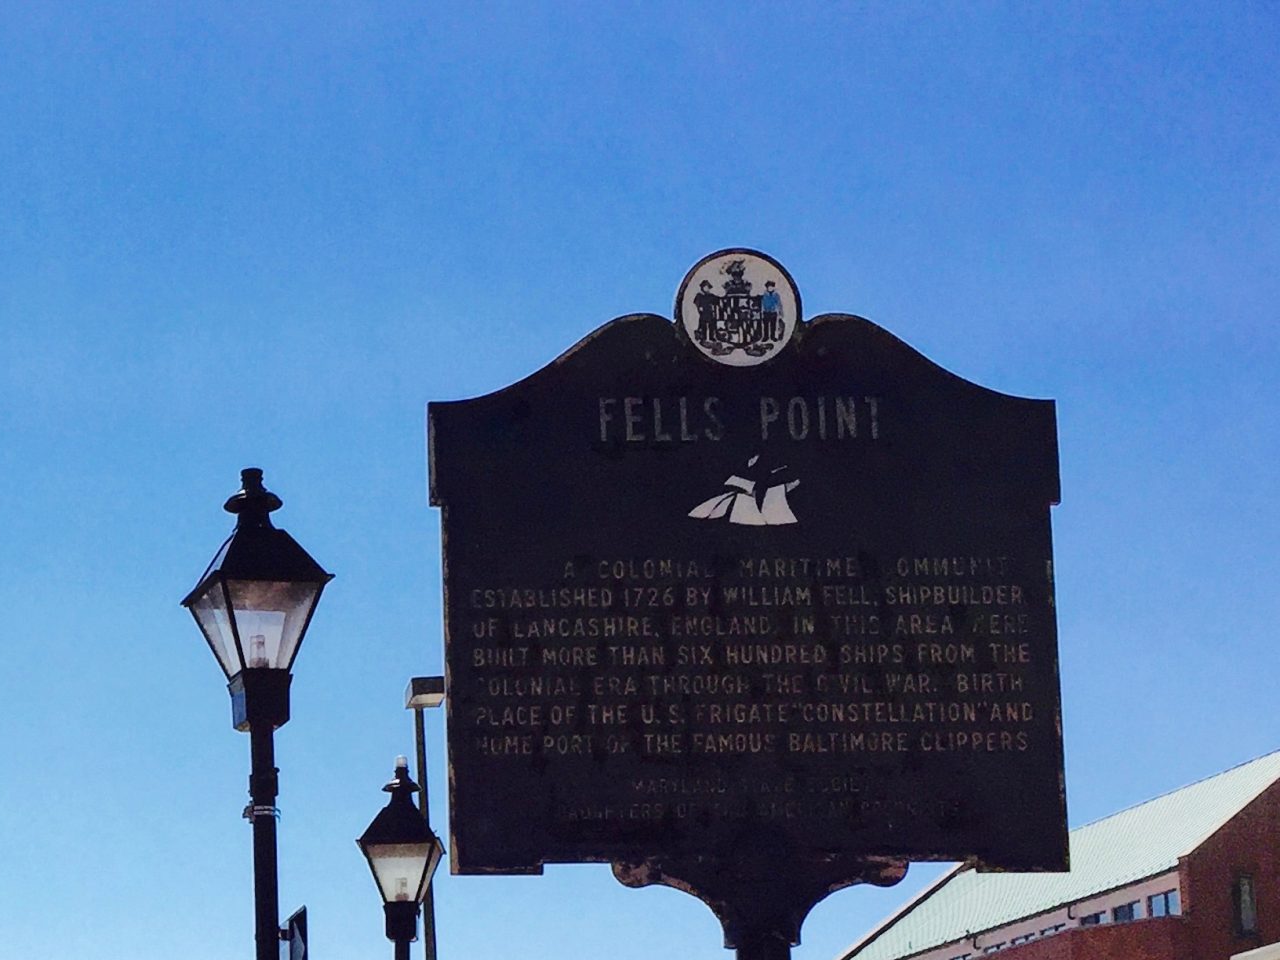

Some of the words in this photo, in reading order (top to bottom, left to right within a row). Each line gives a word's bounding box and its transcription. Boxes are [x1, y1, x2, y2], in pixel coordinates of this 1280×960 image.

[598, 396, 726, 442] FELLS
[759, 395, 881, 441] POINT
[472, 587, 613, 609] ESTABLISHED
[622, 586, 675, 608] 1726
[686, 587, 712, 607] BY
[722, 585, 812, 607] WILLIAM
[472, 618, 499, 639] OF
[793, 615, 815, 635] IN
[895, 614, 954, 635] AREA
[542, 646, 598, 667] MORE
[609, 646, 665, 666] THAN
[677, 646, 714, 665] SIX
[725, 644, 827, 665] HUNDRED
[839, 644, 904, 664] SHIPS
[917, 643, 976, 664] FROM
[988, 643, 1031, 663] THE
[593, 676, 638, 696] ERA
[648, 675, 751, 696] THROUGH
[761, 673, 803, 694] THE
[956, 672, 1024, 693] BIRTH
[551, 705, 577, 726] OF
[587, 704, 628, 725] THE
[542, 734, 593, 755] PORT
[643, 734, 683, 754] THE
[692, 733, 776, 754] FAMOUS
[788, 732, 909, 753] BALTIMORE
[920, 731, 1029, 752] CLIPPERS
